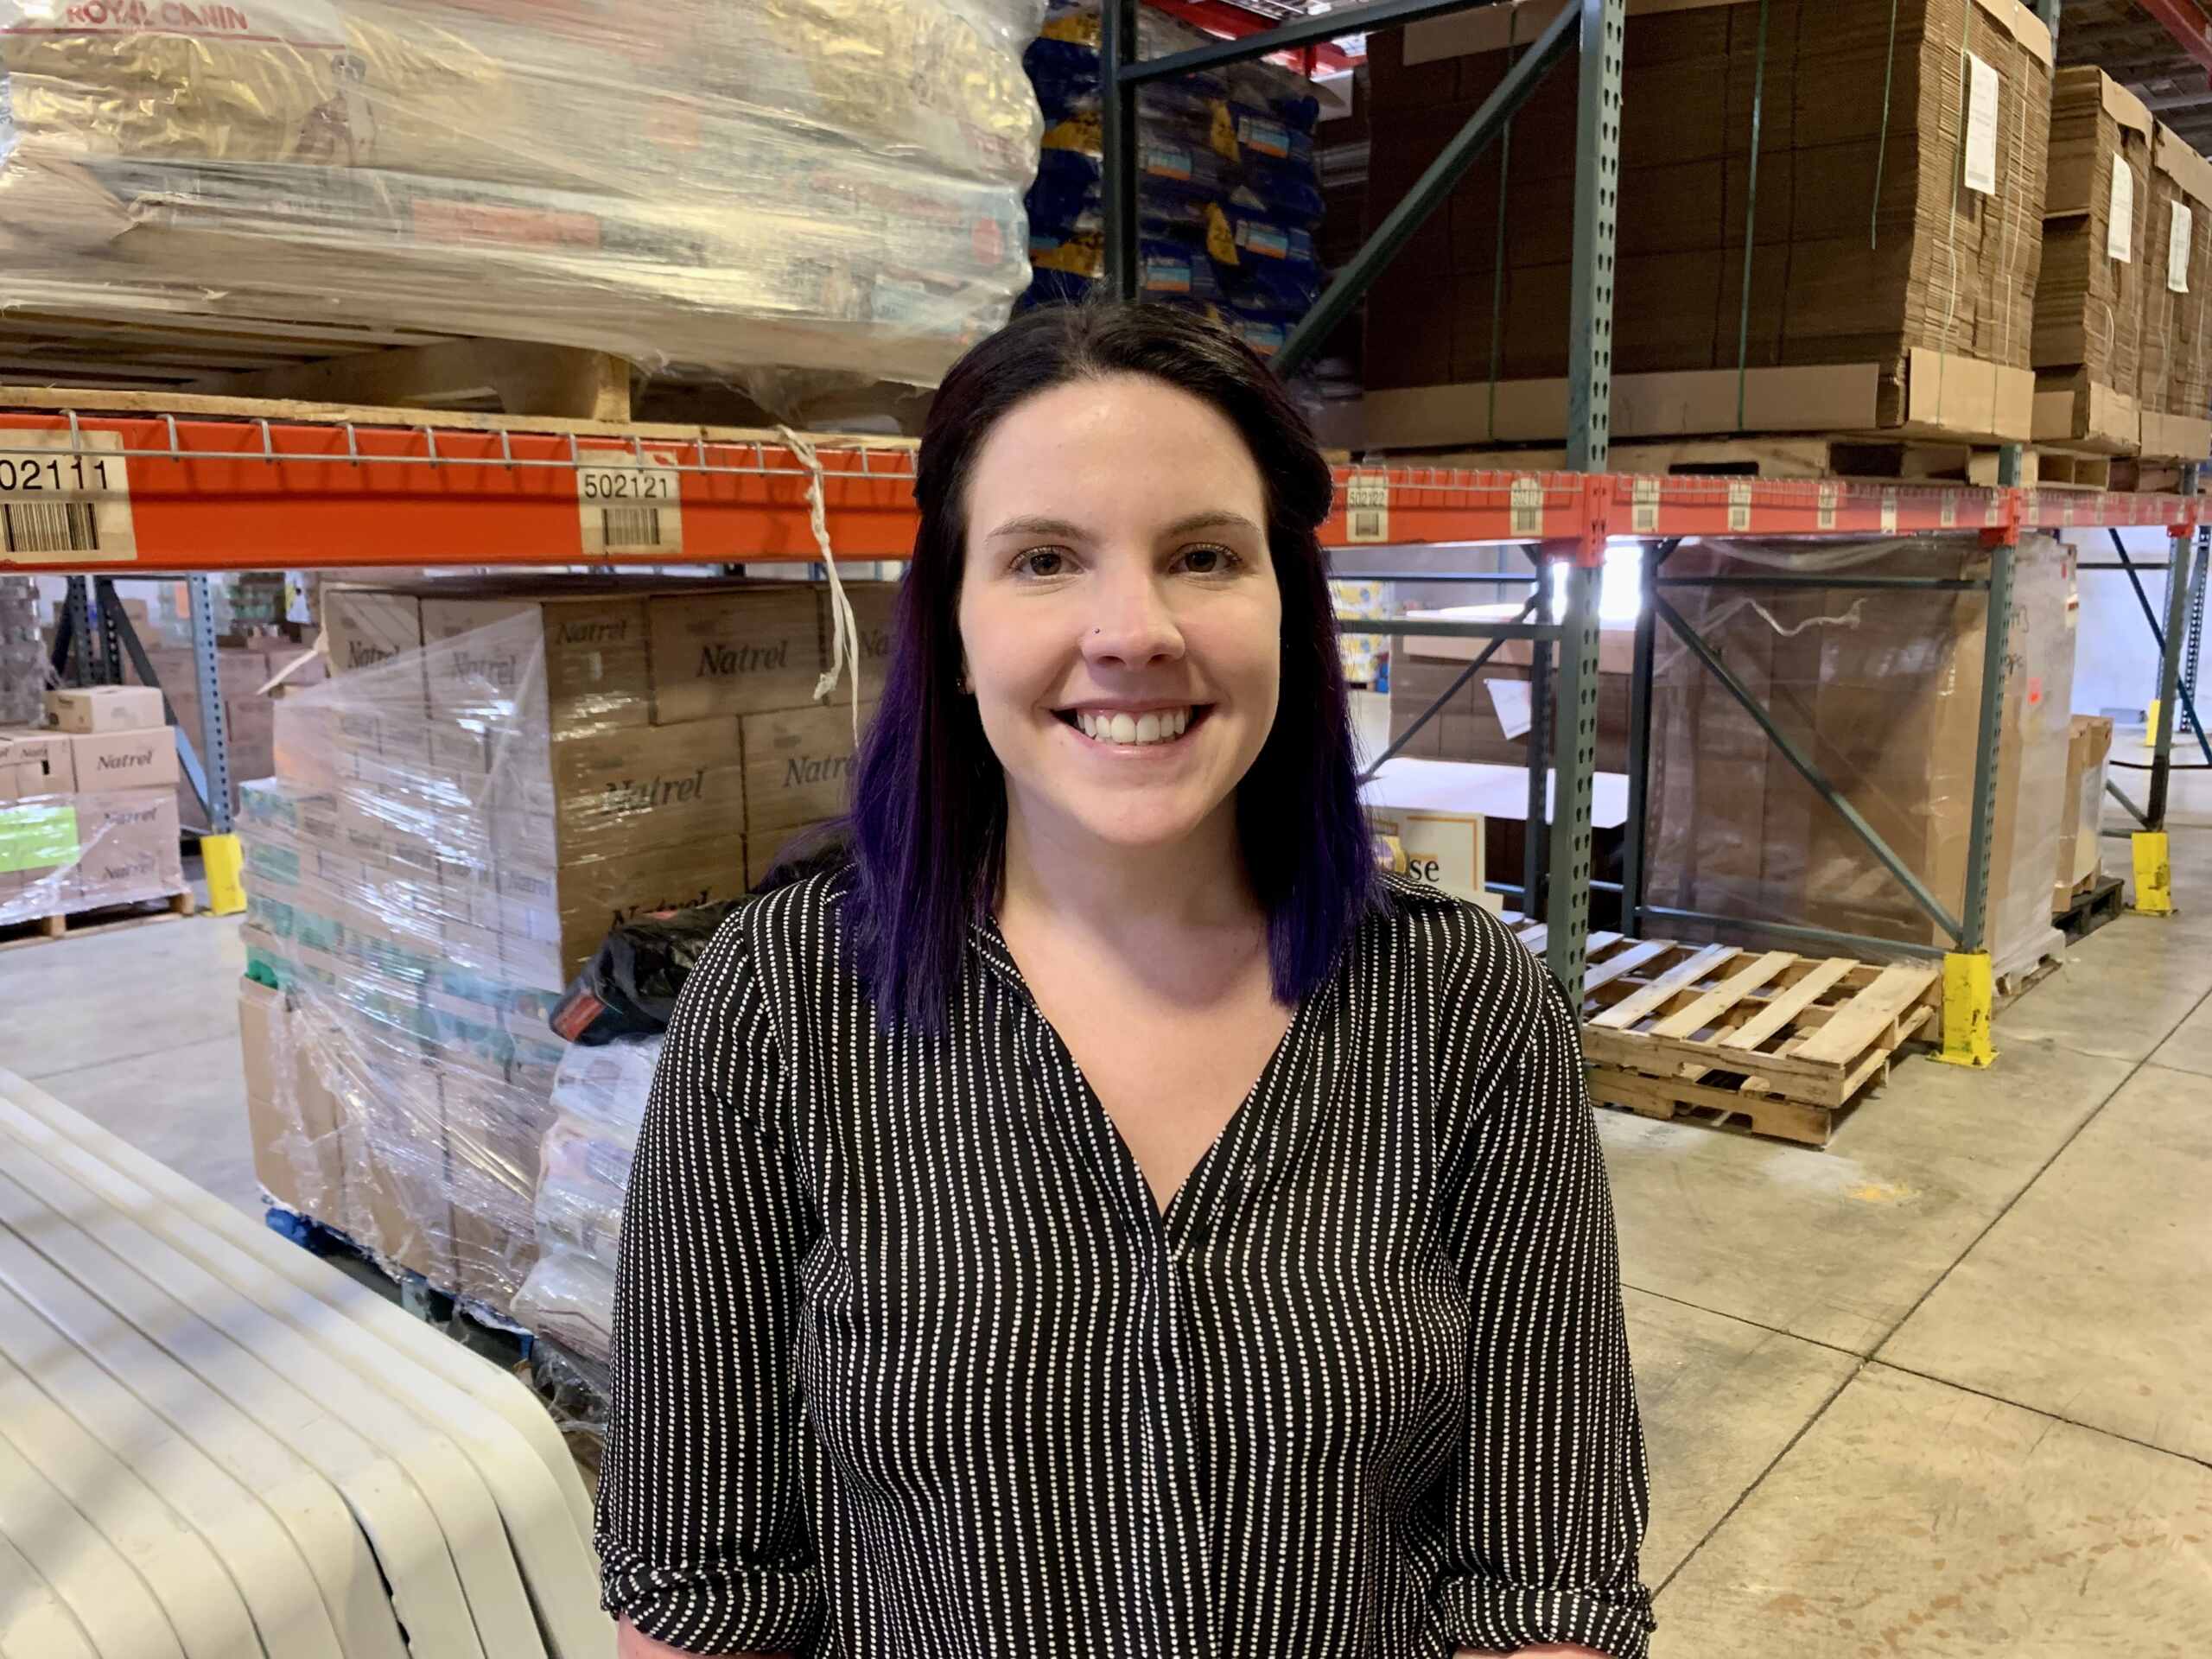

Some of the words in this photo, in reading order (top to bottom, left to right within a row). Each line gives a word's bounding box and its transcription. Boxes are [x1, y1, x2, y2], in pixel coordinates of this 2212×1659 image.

[67, 0, 155, 26] ROYAL
[160, 2, 249, 29] CANIN
[585, 474, 667, 499] 502121
[696, 640, 788, 678] Natrel
[97, 749, 154, 771] Natrel
[781, 754, 858, 788] Natre
